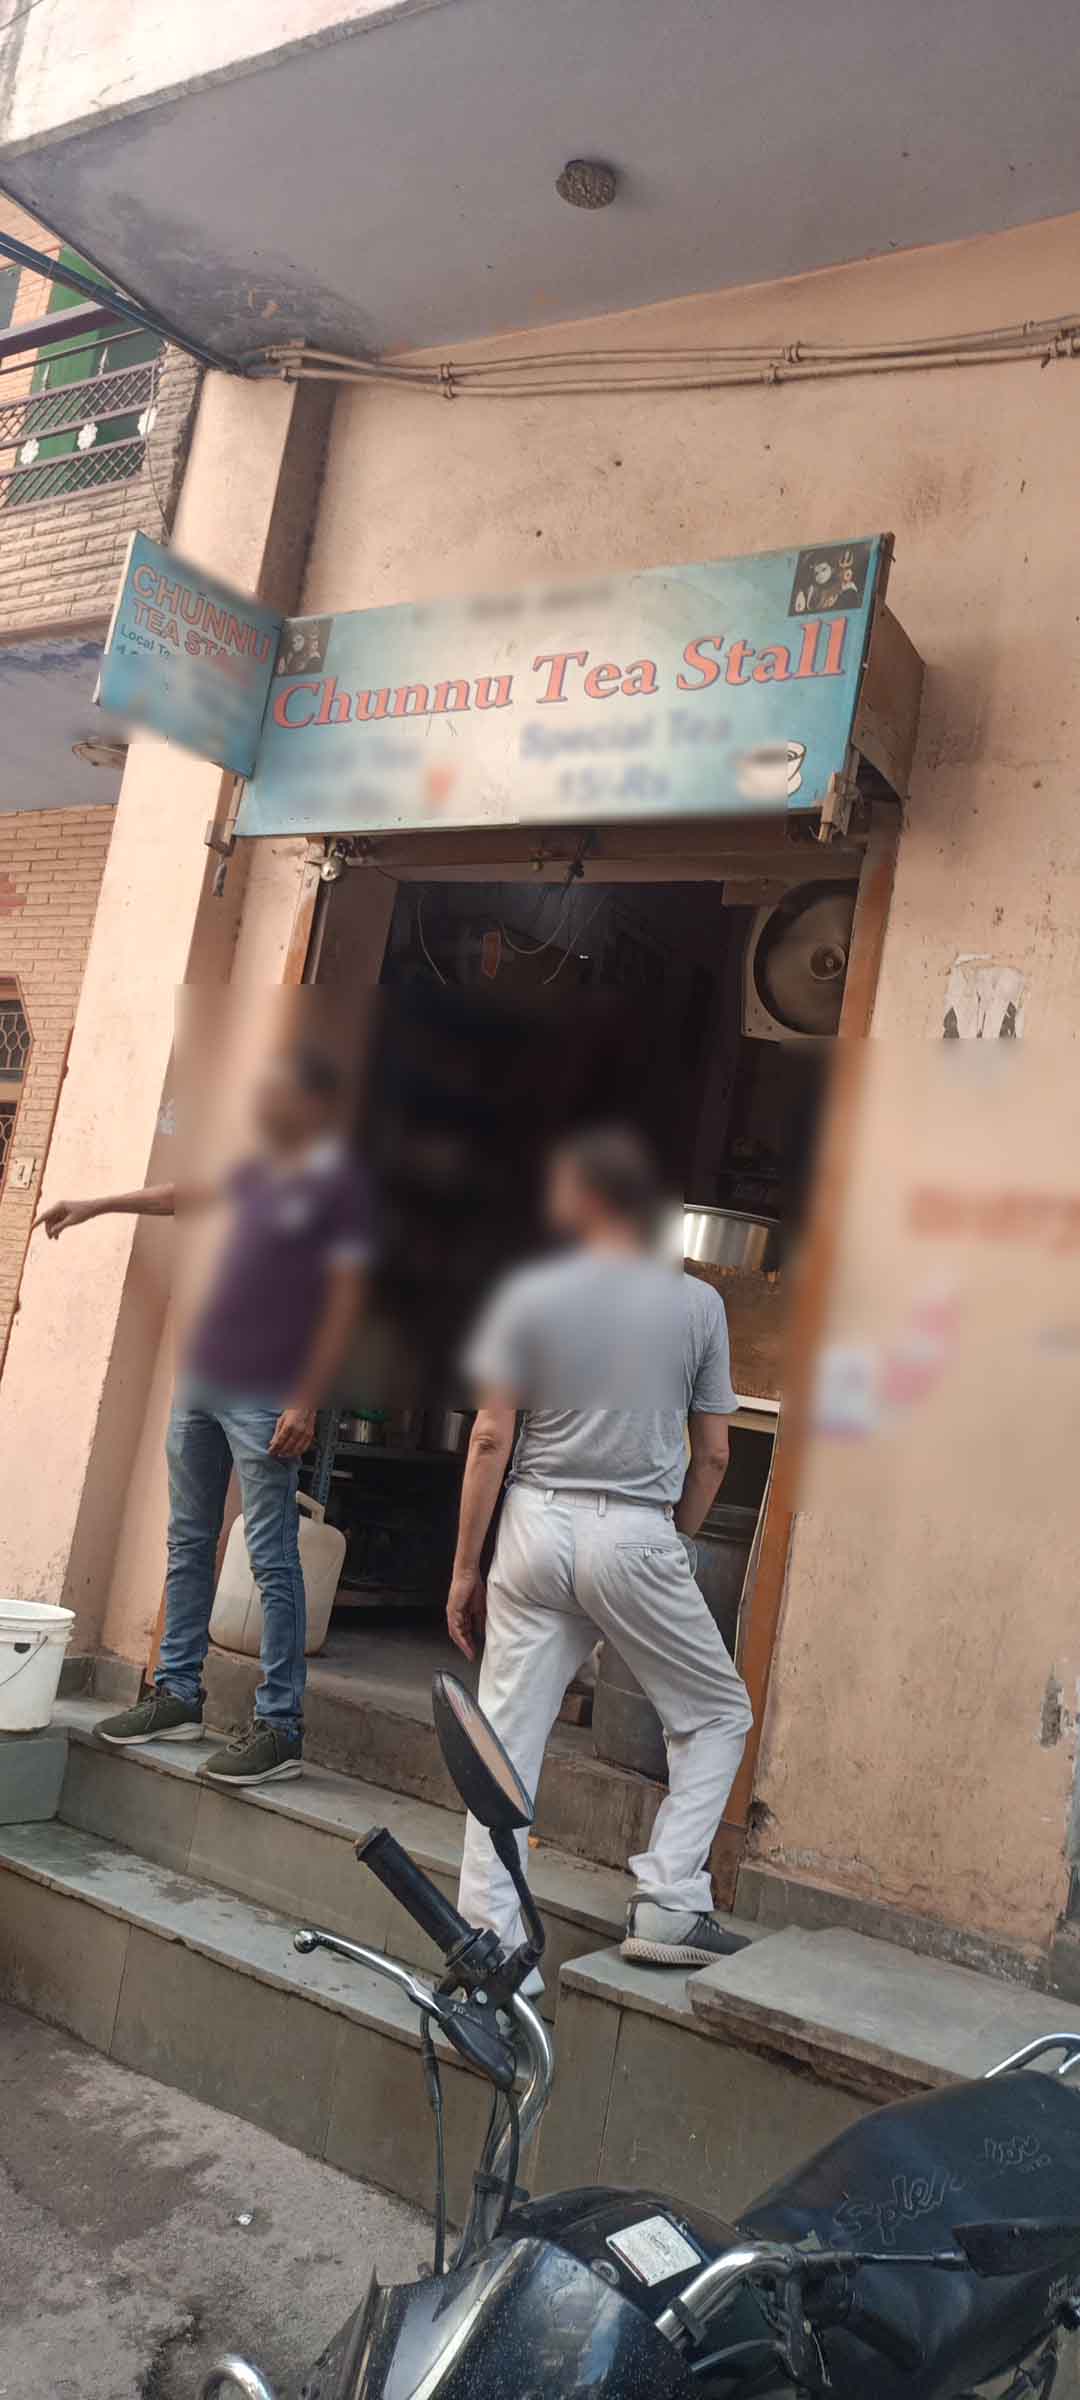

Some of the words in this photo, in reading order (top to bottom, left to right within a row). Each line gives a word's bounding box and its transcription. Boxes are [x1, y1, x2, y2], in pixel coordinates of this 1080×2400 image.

[120, 624, 155, 651] Local
[132, 563, 273, 664] CHUNNU
[132, 598, 181, 647] TEA
[272, 675, 514, 729] Chunnu
[531, 650, 660, 704] Tea
[675, 615, 848, 691] Stall
